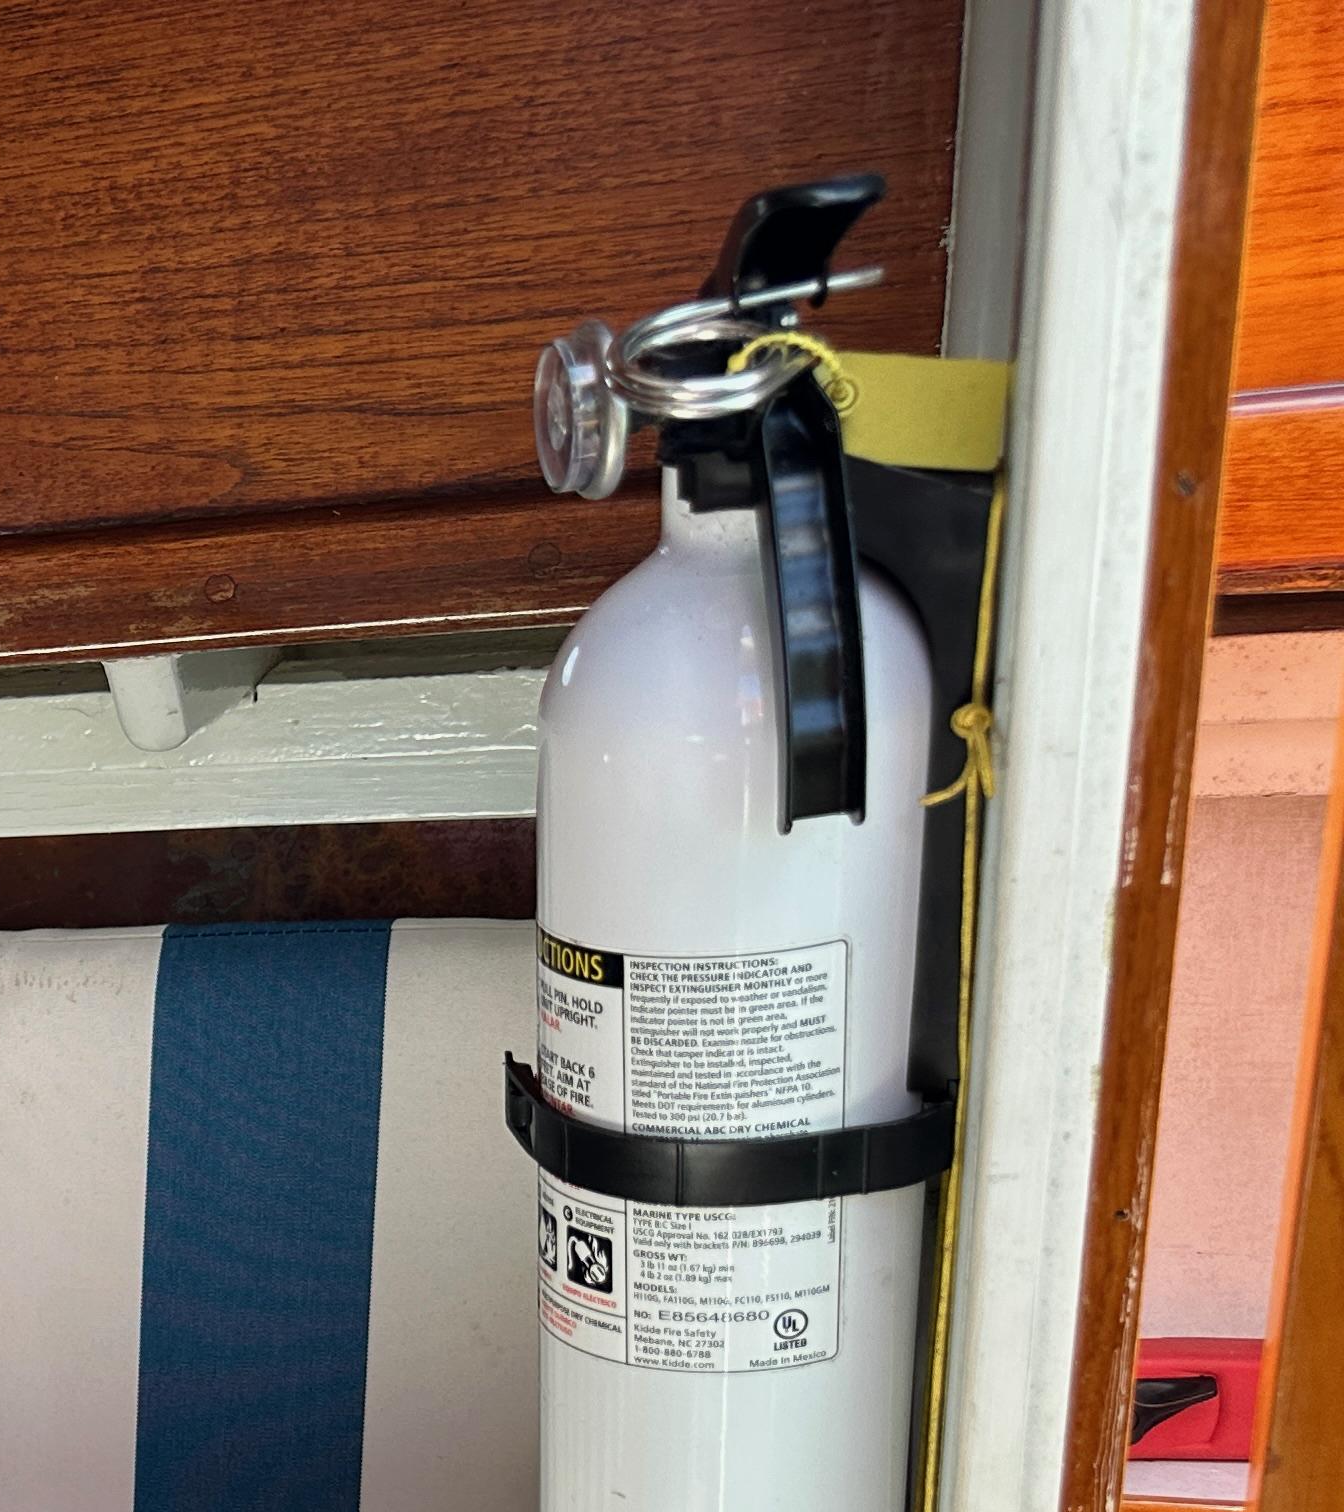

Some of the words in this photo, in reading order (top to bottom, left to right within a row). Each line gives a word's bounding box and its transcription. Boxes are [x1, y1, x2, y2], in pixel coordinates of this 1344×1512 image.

[630, 961, 690, 971] INSPECTION
[693, 957, 779, 971] INSTRUCTIONS:
[630, 972, 658, 981] CHECK
[661, 974, 678, 982] THE
[681, 973, 730, 982] PRESSURE
[733, 967, 787, 980] INDICATOR
[791, 963, 813, 973] AND
[630, 983, 666, 992] INSPECT
[669, 983, 741, 993] EXTINGUISHER
[744, 977, 792, 990] MONTHLY
[572, 996, 604, 1014] HOLD
[749, 1003, 774, 1014] green
[554, 1004, 598, 1029] UPRIGHT.
[800, 1014, 826, 1027] MUST
[631, 1036, 642, 1045] BE
[643, 1037, 699, 1047] DISCARDED.
[560, 1056, 585, 1076] BACK
[588, 1066, 595, 1079] 6
[577, 1078, 591, 1092] AT
[570, 1090, 593, 1108] FIRE.
[632, 1123, 701, 1135] COMMERCIAL
[729, 1125, 751, 1134] DRY
[755, 1118, 810, 1132] CHEMICAL
[633, 1208, 672, 1220] MARINE
[674, 1212, 701, 1220] TYPE
[633, 1217, 652, 1228] TYPE
[633, 1228, 654, 1237] USCG
[633, 1249, 665, 1260] GROSS
[633, 1282, 677, 1293] MODELS:
[633, 1310, 651, 1319] NO:
[633, 1323, 661, 1334] Kidde
[664, 1327, 682, 1336] Fire
[684, 1328, 716, 1339] Safety
[633, 1334, 675, 1347] Mebane,
[678, 1340, 692, 1348] NC
[695, 1340, 725, 1348] 27302
[773, 1338, 807, 1351] LISTED
[635, 1345, 712, 1359] 1-800-880-6788
[749, 1358, 778, 1368] Made
[793, 1350, 827, 1362] Mexico
[634, 1356, 715, 1369] www.Kidde.com
